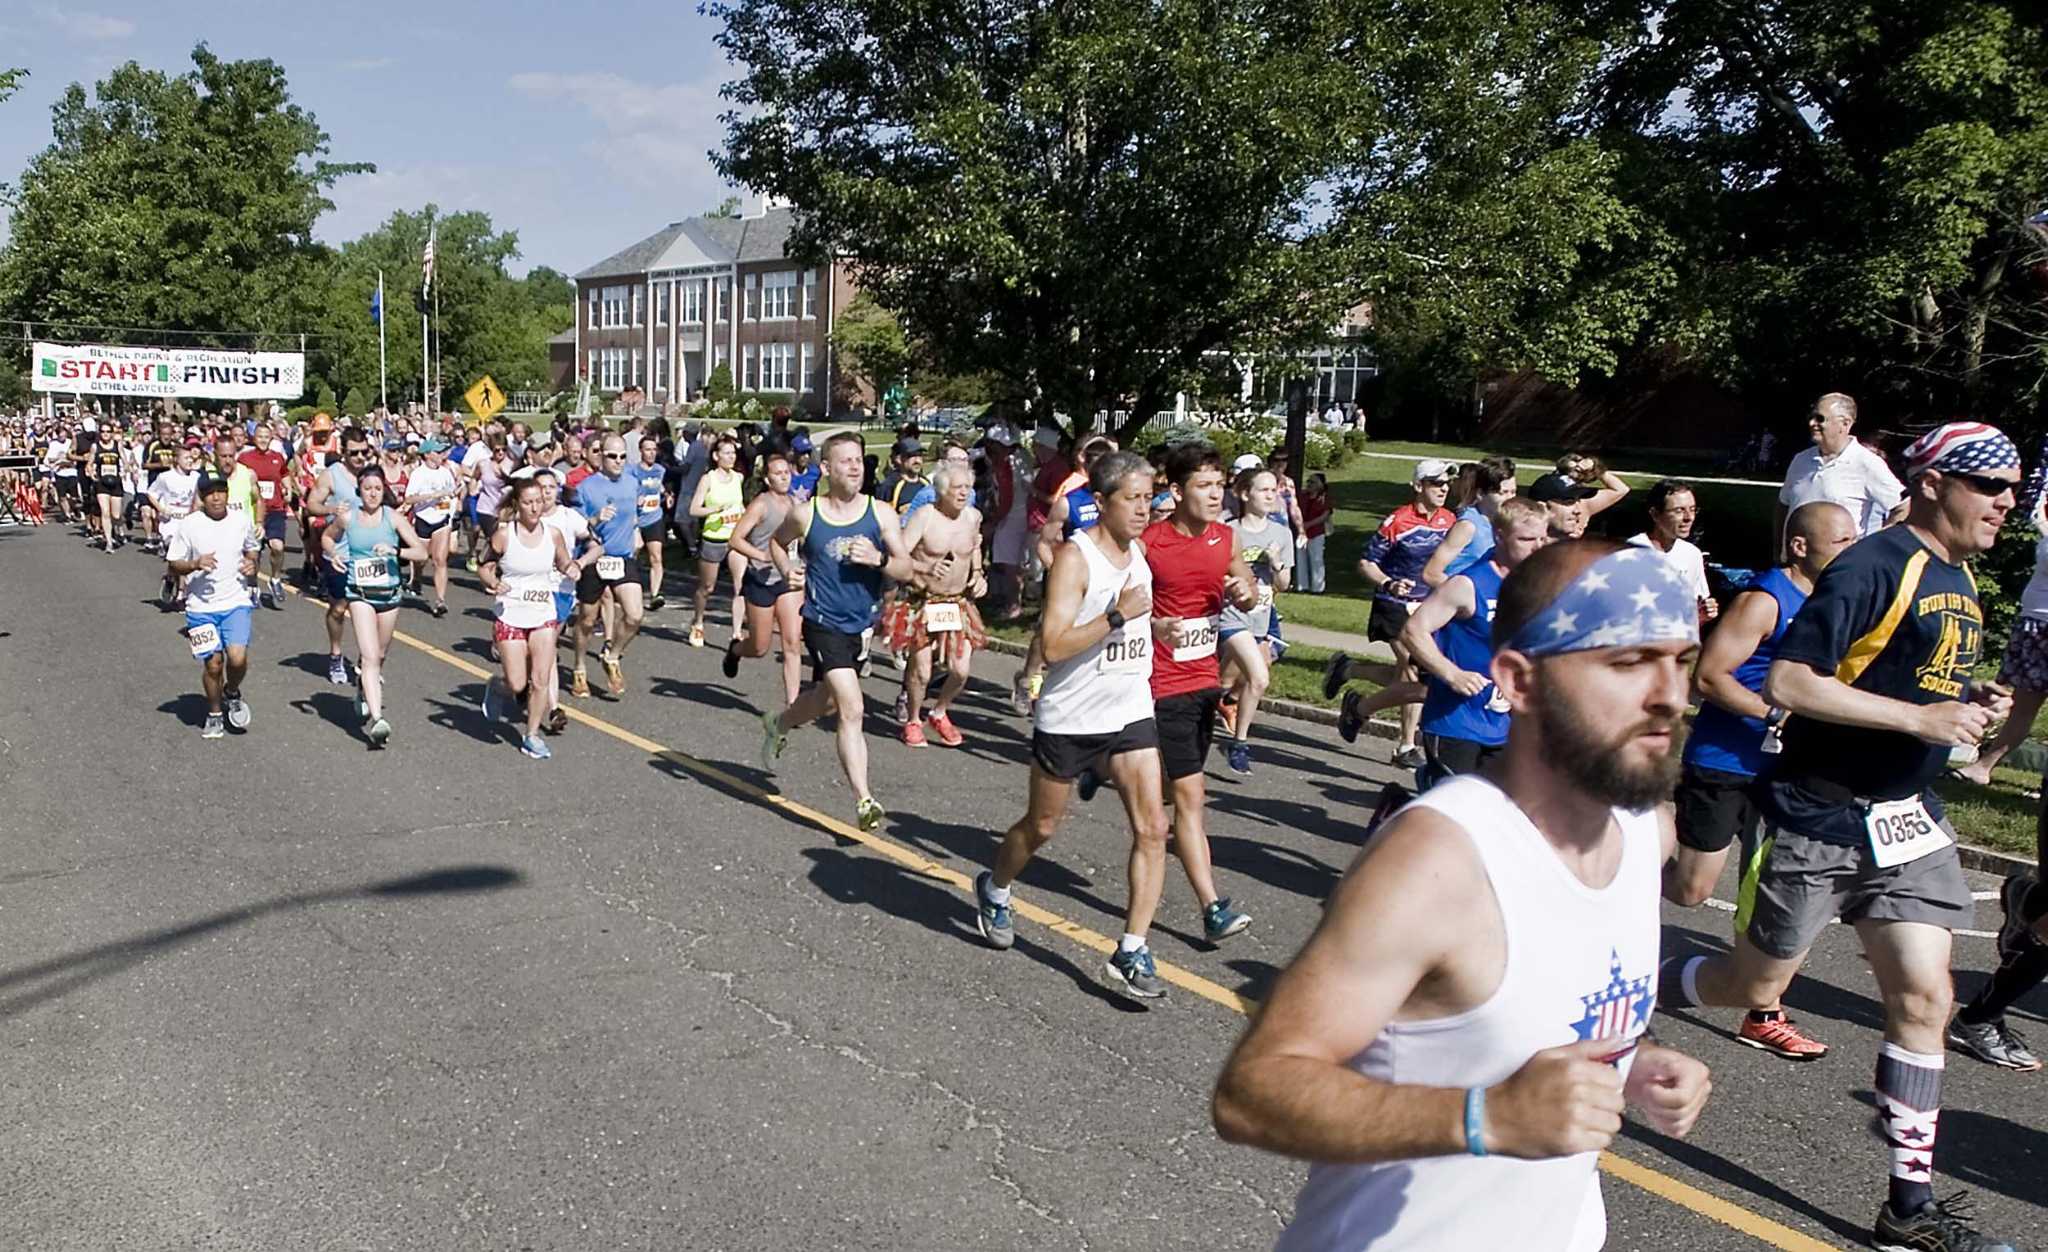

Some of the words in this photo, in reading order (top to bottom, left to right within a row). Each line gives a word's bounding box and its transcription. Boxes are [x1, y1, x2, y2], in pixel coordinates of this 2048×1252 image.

[90, 348, 130, 359] BETHEL
[60, 360, 156, 381] START
[183, 365, 280, 384] FINISH
[523, 590, 549, 603] 0292
[1918, 592, 1946, 617] RUN
[1106, 637, 1147, 662] 0182
